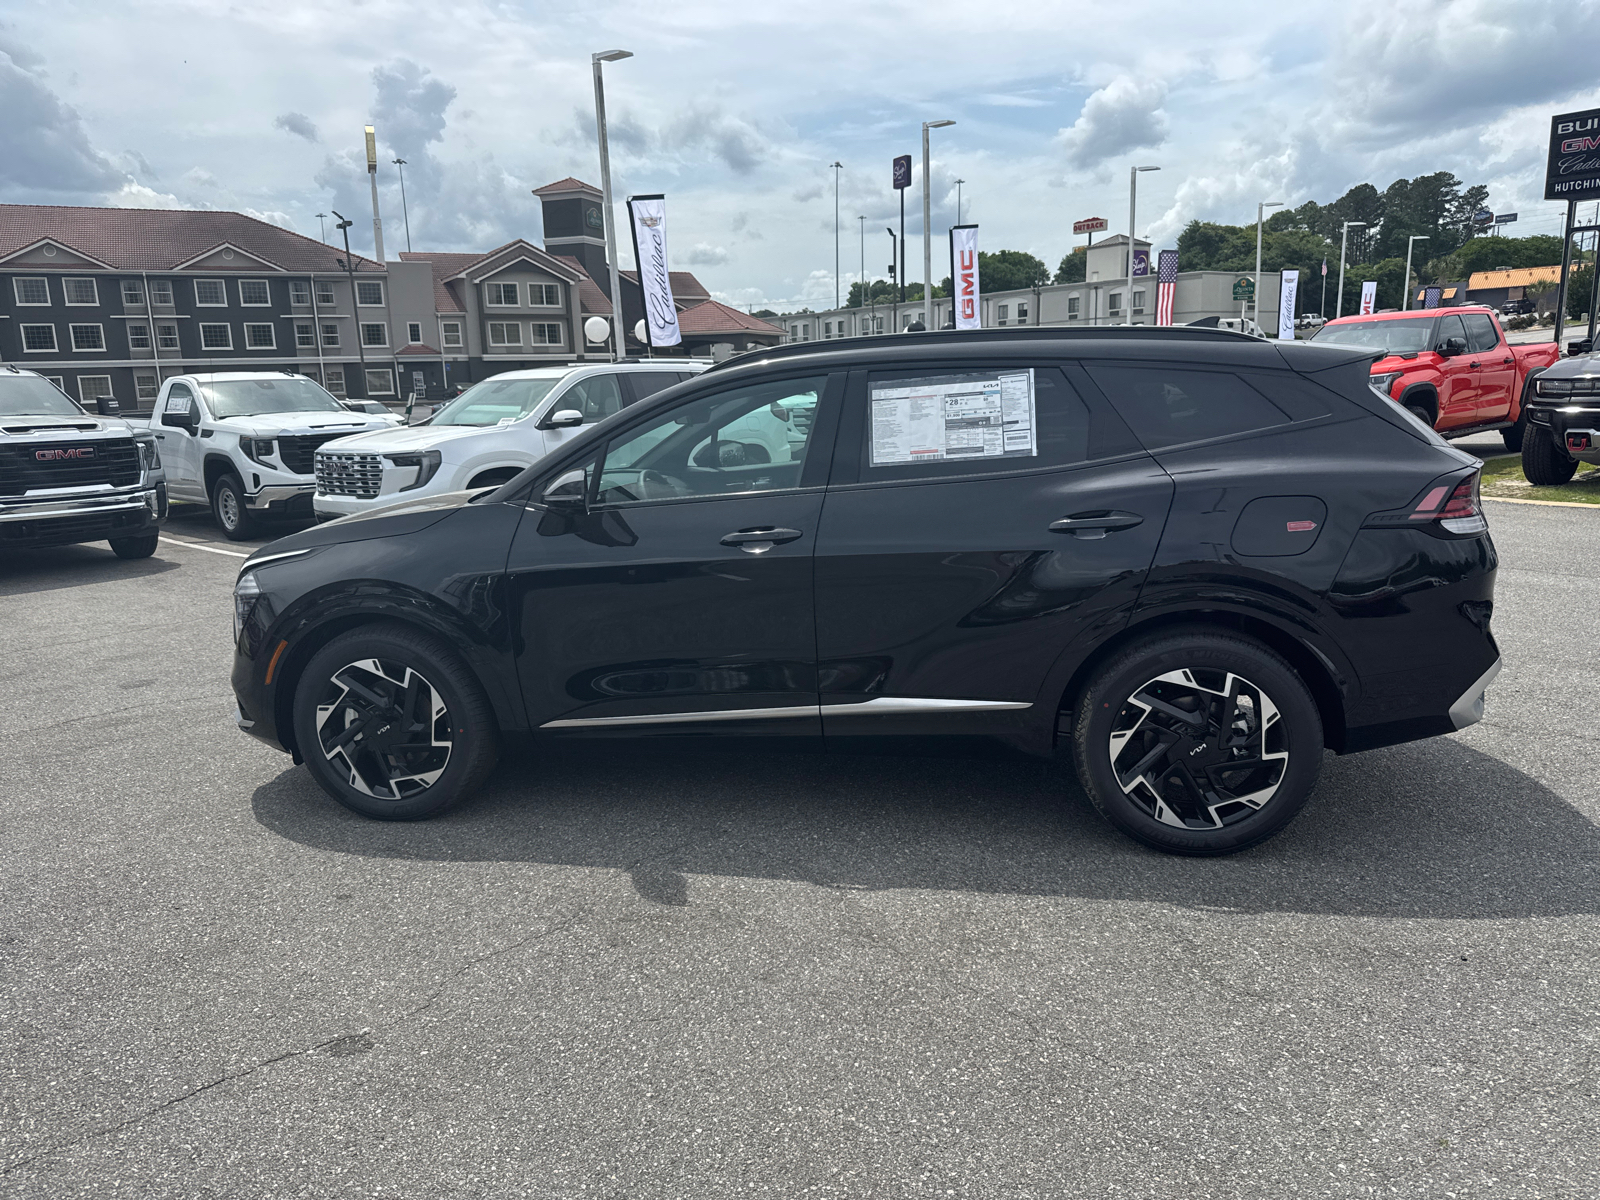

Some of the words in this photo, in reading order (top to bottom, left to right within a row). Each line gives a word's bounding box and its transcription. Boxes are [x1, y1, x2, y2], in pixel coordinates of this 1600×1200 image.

[1073, 221, 1104, 232] OUTBACK
[650, 233, 676, 330] Cadillac
[960, 249, 975, 320] GMC
[1282, 286, 1293, 332] Cadillac
[35, 447, 94, 461] GMC
